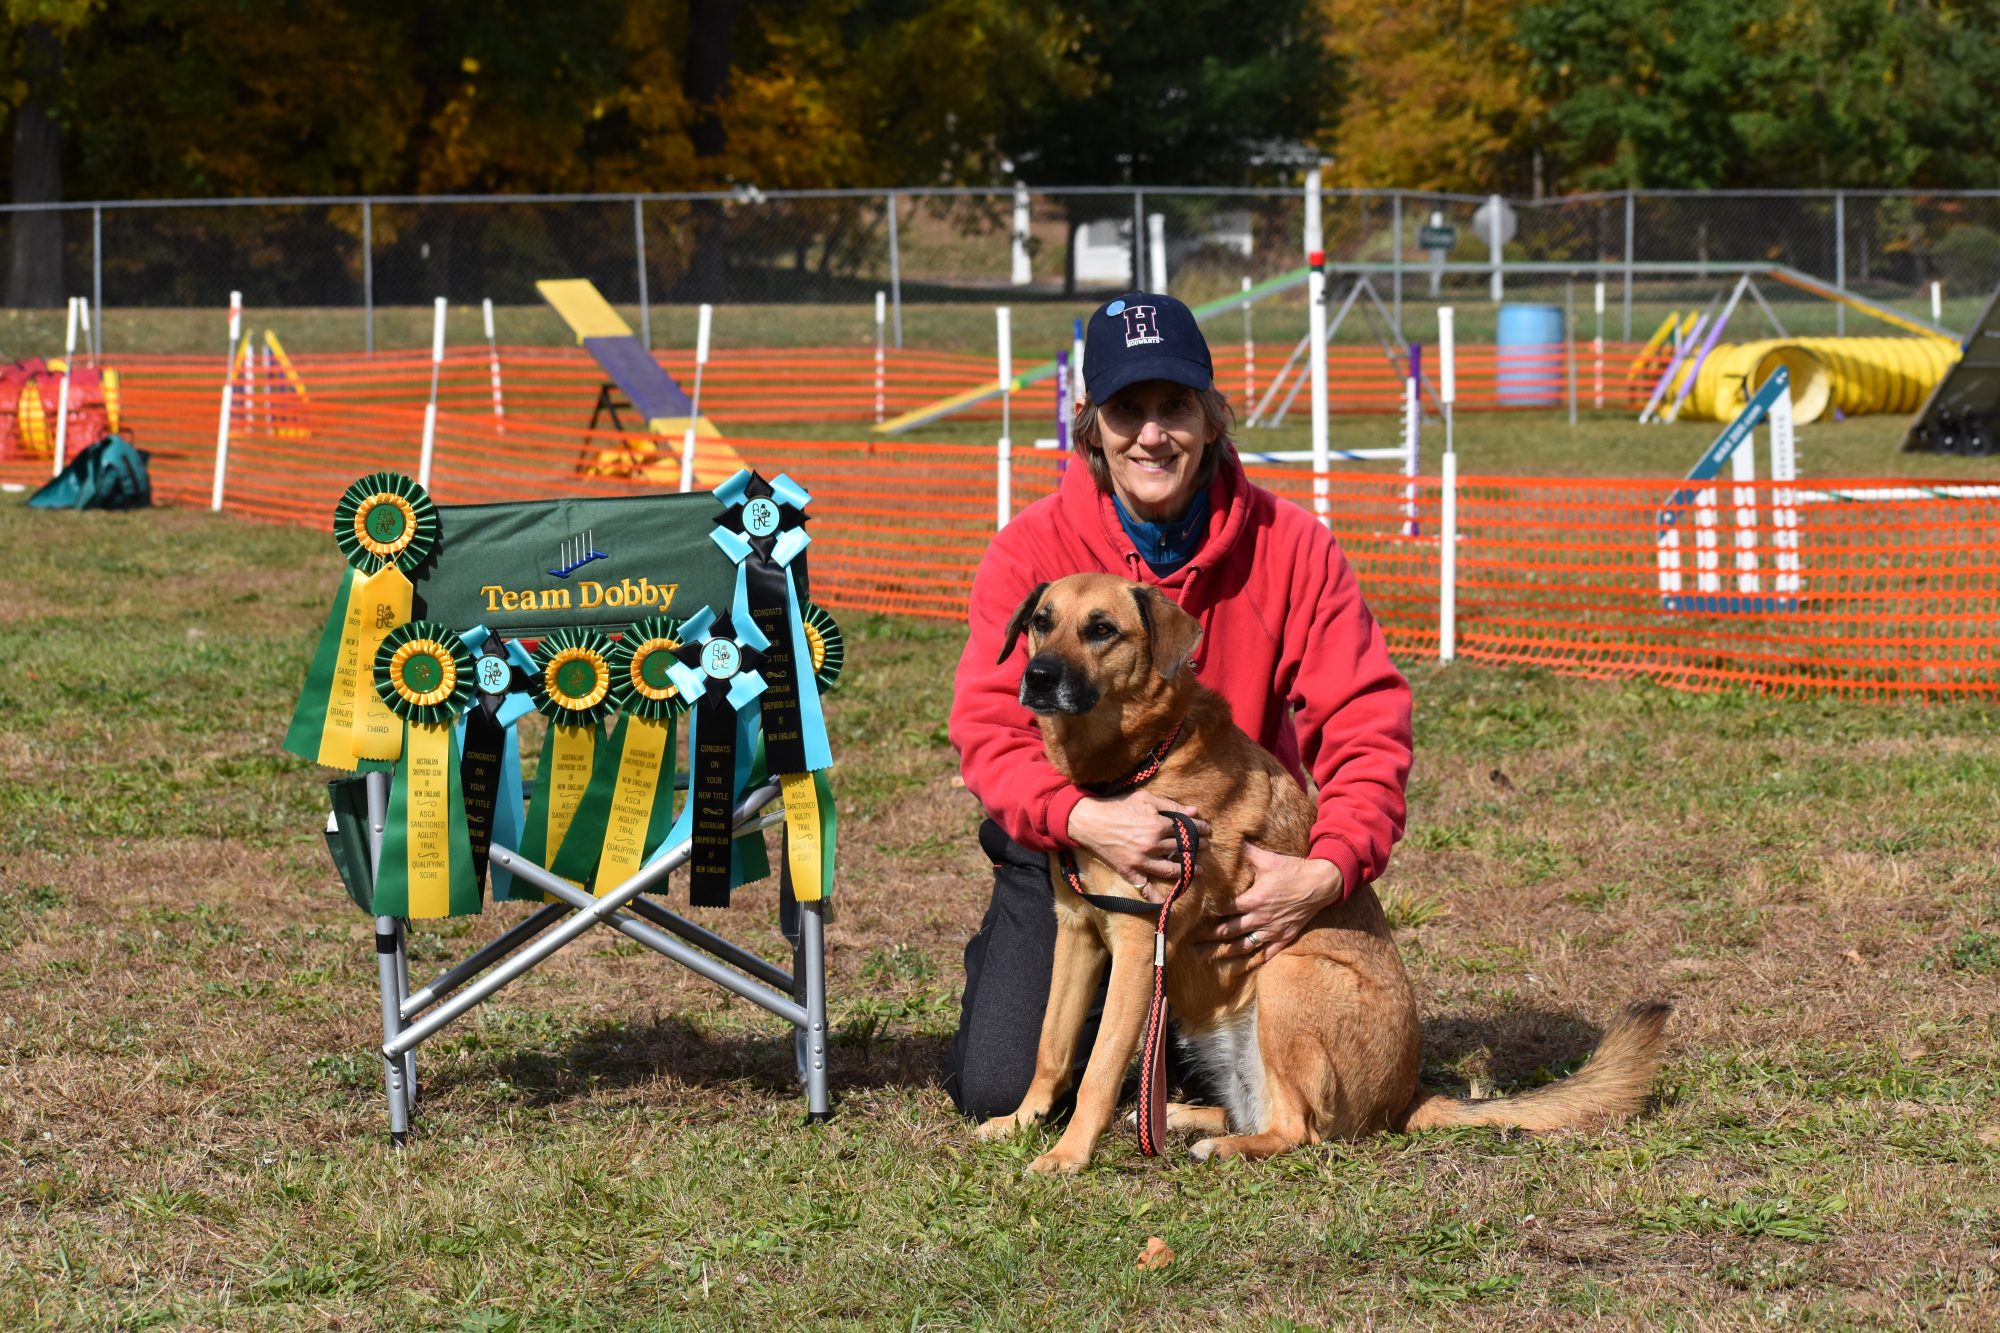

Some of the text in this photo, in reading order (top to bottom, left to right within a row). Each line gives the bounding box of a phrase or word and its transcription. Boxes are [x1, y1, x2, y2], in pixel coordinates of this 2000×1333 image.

[1123, 305, 1160, 341] H
[480, 577, 679, 612] Team Dobby
[753, 607, 783, 617] CONGRATS
[765, 624, 774, 632] ON
[343, 690, 355, 698] TRIA
[330, 707, 353, 718] QUALIFY
[367, 725, 389, 734] THIRD
[700, 744, 731, 753] CONGRATS
[466, 751, 497, 762] CONGRATS
[416, 757, 439, 766] AUSTRALIAN
[710, 760, 720, 769] ON
[475, 767, 485, 776] ON
[621, 776, 652, 789] NEW ENGLAND
[706, 776, 722, 785] YOUR
[470, 782, 487, 792] YOUR
[557, 783, 566, 791] NEW
[414, 790, 422, 798] NEW
[698, 791, 729, 800] NEW TITLE
[791, 791, 806, 799] ASCA
[475, 799, 491, 809] TITLE
[624, 795, 641, 806] ASCA
[612, 803, 649, 818] SANCTIONED
[787, 801, 816, 811] SANCTIONED
[419, 810, 436, 818] ASCA
[794, 812, 811, 820] AGILITY
[410, 821, 446, 829] SANCTIONED
[617, 815, 640, 826] AGILITY
[618, 825, 635, 836] TRIAL
[797, 823, 811, 831] TRIAL
[417, 831, 439, 839] AGILITY
[606, 842, 640, 857] QUALIFYING
[611, 854, 631, 865] SCORE
[411, 860, 445, 869] QUALIFYING
[419, 871, 438, 879] SCORE
